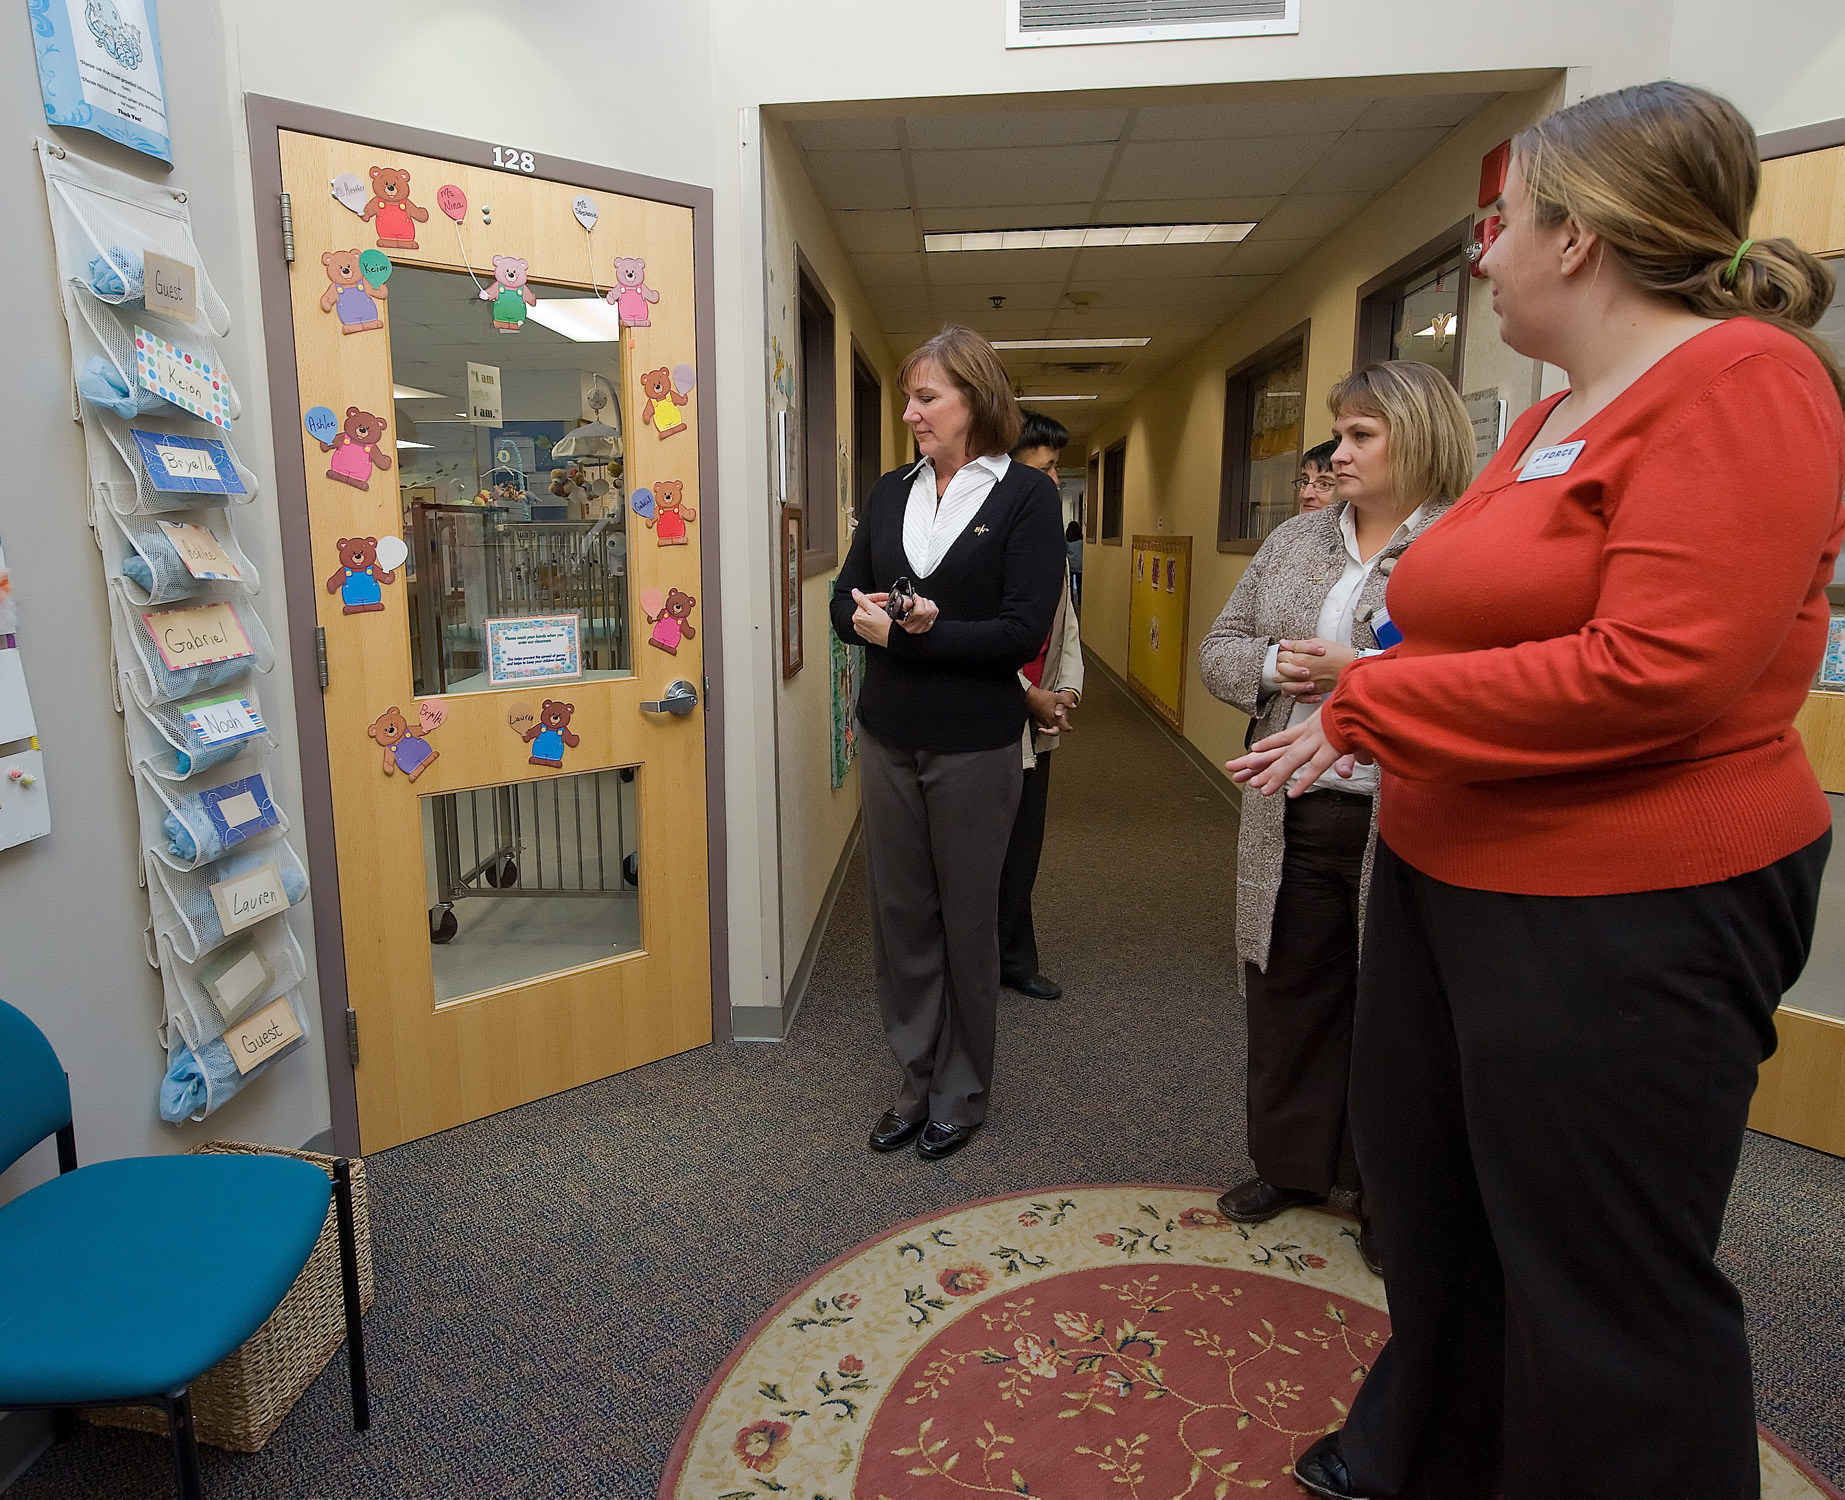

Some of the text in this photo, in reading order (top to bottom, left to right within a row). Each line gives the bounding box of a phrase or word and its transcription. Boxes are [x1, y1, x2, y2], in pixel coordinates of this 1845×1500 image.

[117, 108, 131, 118] Thank
[492, 146, 536, 173] 128
[443, 199, 464, 211] Nina
[155, 269, 184, 301] Guest
[168, 364, 202, 400] Keion
[481, 374, 495, 385] am
[308, 414, 336, 432] Ashlee
[161, 452, 218, 474] Bryella
[1543, 447, 1576, 460] FORCE
[181, 538, 217, 561] Ashlee
[164, 621, 228, 654] Gabriel
[203, 709, 243, 734] Noah
[233, 889, 278, 916] Lauren
[241, 1019, 283, 1054] Guest
